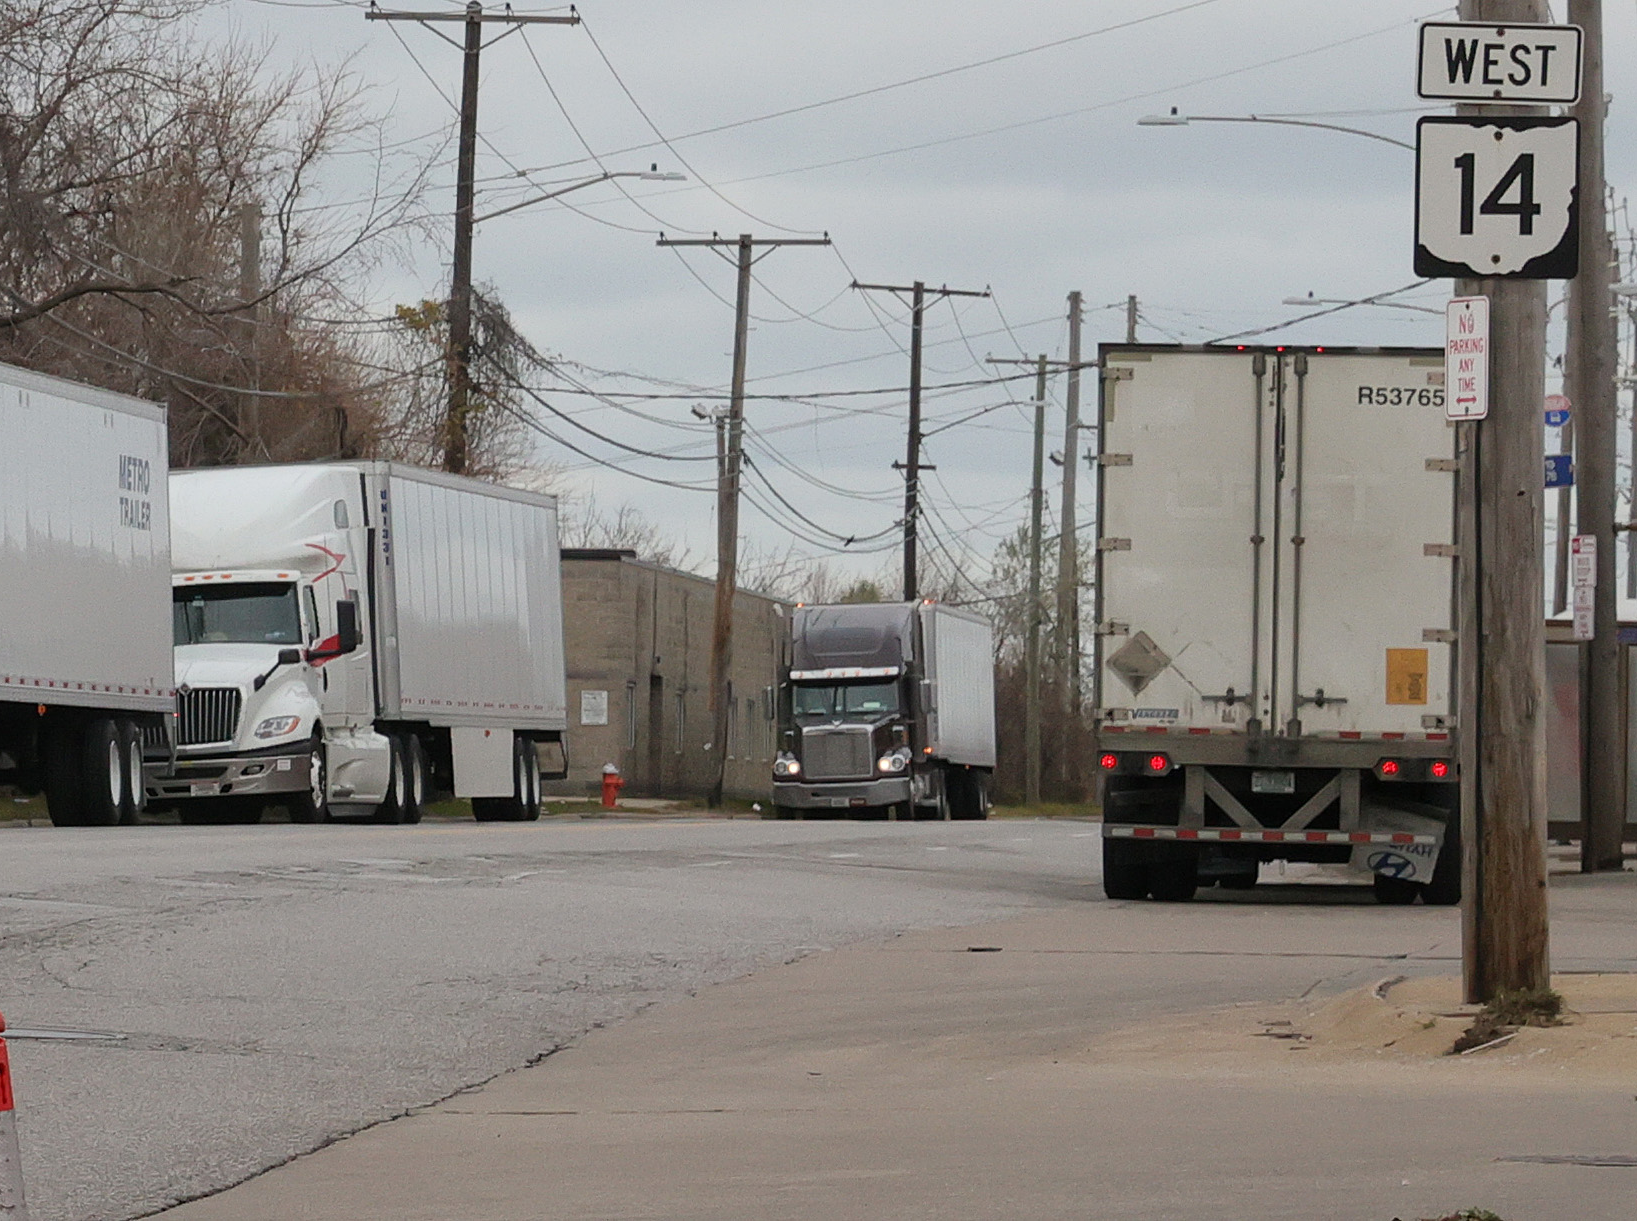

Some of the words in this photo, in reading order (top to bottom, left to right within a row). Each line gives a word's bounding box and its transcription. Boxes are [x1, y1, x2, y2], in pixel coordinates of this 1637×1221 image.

[1444, 38, 1557, 87] WEST
[1454, 152, 1541, 235] 14
[1458, 313, 1475, 334] NO
[1449, 338, 1484, 355] PARKING
[1458, 358, 1475, 373] ANY
[1457, 377, 1476, 393] TIME
[1358, 386, 1445, 406] R53765
[119, 454, 150, 496] METRO
[119, 497, 151, 531] TRAILER
